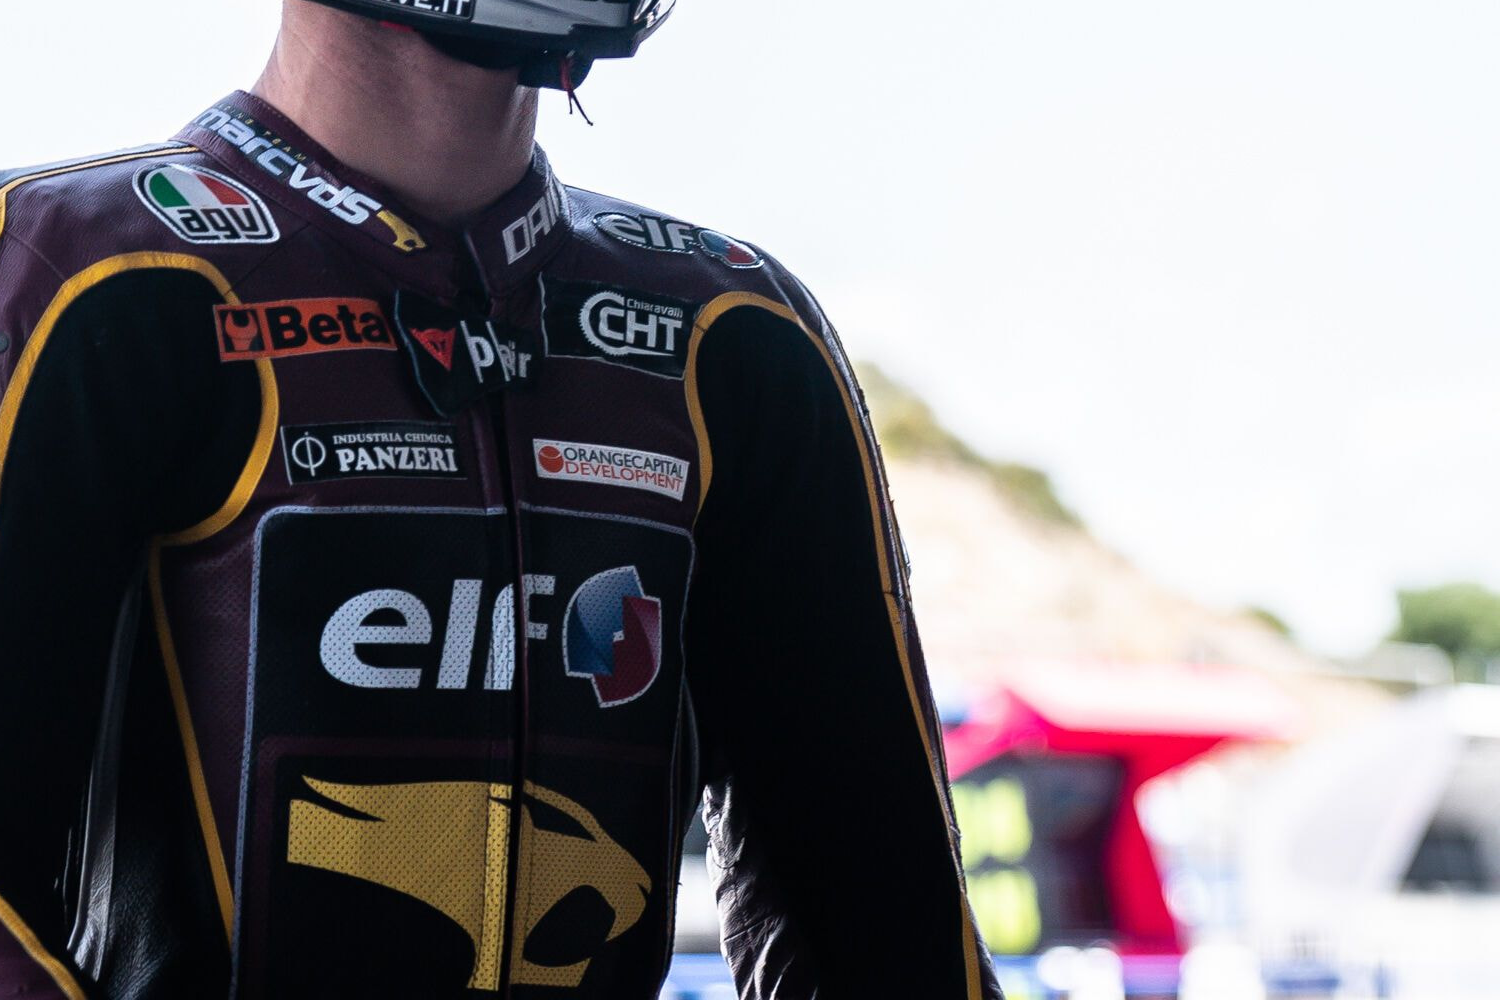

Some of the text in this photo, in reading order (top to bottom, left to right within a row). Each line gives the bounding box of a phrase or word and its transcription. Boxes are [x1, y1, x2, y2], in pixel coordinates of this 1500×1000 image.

[177, 207, 260, 239] agv
[597, 213, 694, 250] elf
[265, 305, 391, 350] Beta
[598, 306, 683, 351] CHT
[332, 432, 453, 445] INDUSTRIA CHIMICA
[335, 446, 458, 472] PANZERI
[565, 461, 683, 492] DEVELOPMENT
[319, 574, 556, 691] elf
